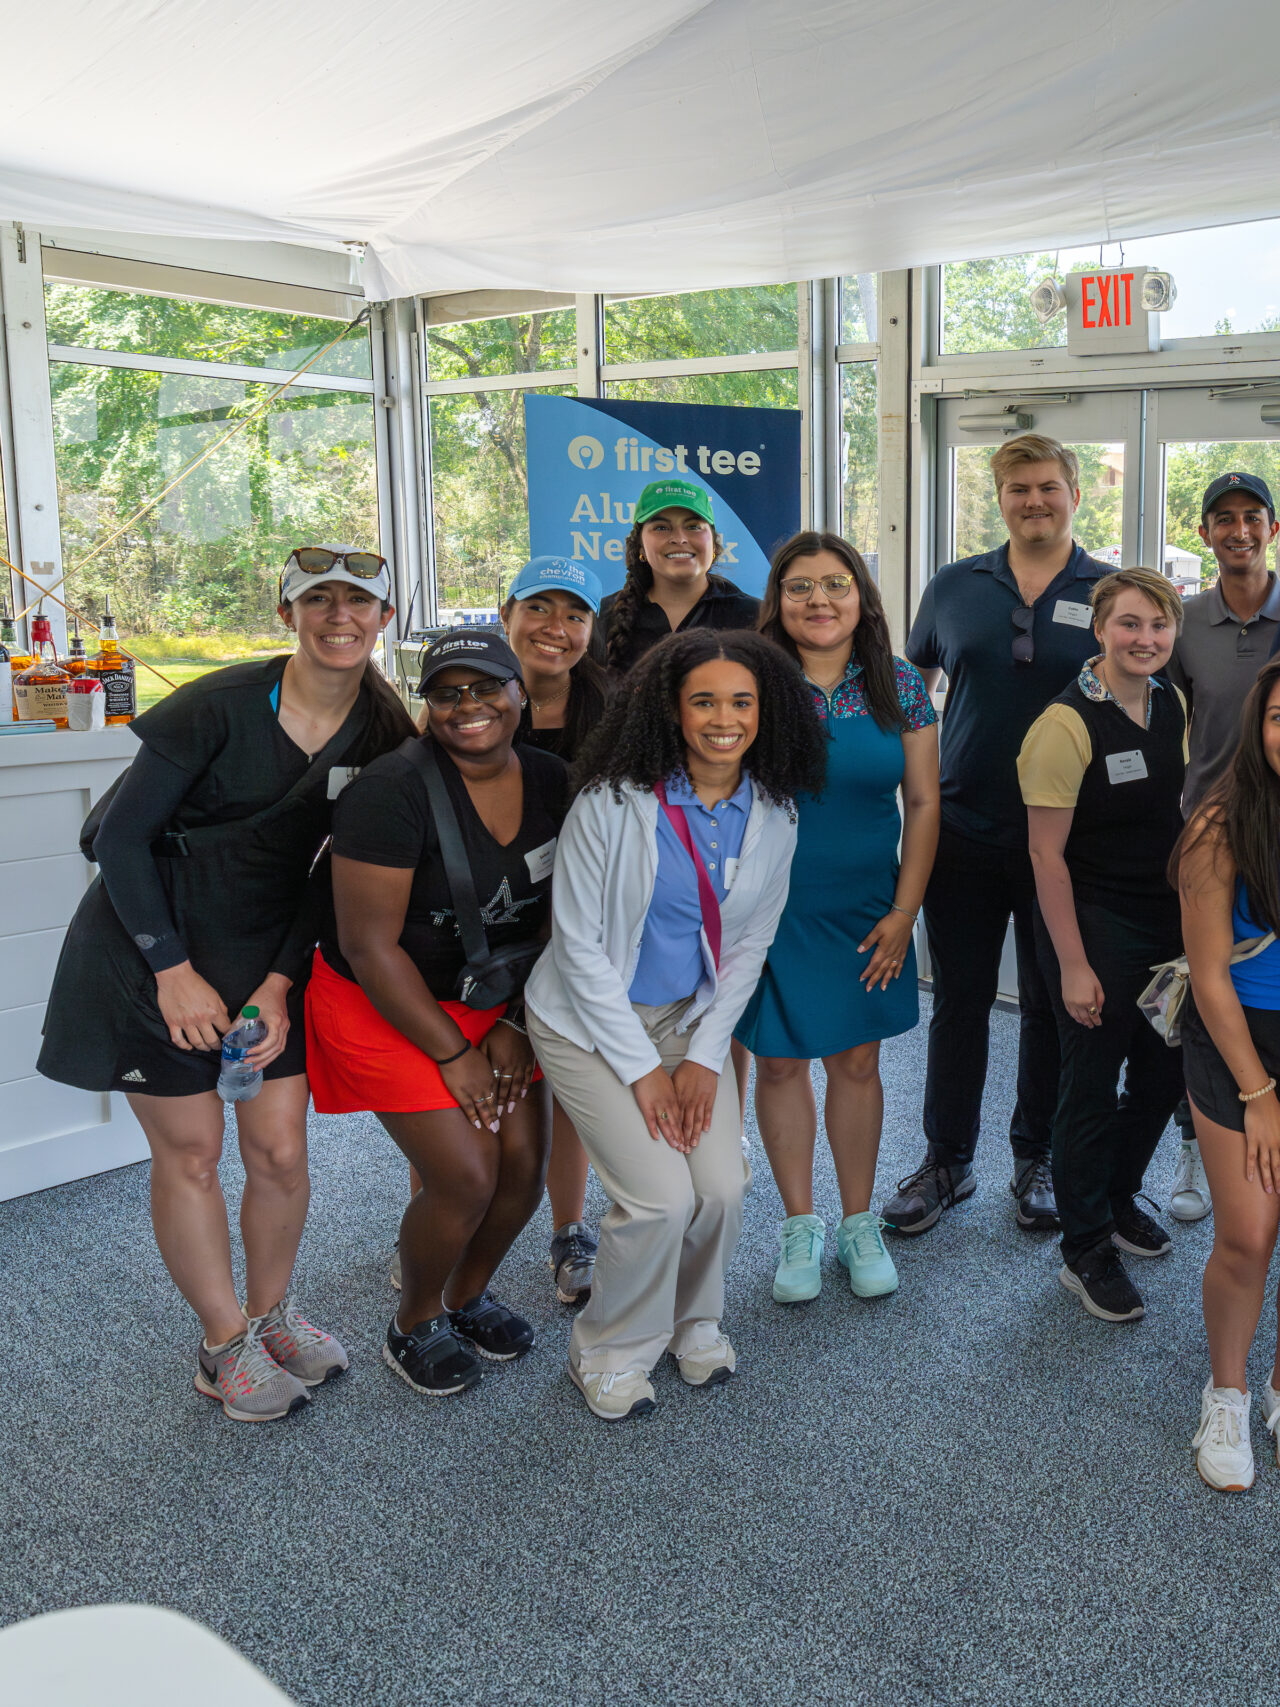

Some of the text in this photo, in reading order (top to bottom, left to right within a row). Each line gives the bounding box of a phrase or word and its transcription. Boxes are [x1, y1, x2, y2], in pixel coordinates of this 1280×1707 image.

[1082, 273, 1134, 328] EXIT
[614, 437, 761, 476] first tee
[540, 567, 585, 582] chevron
[569, 565, 585, 577] the
[442, 639, 489, 650] first tee
